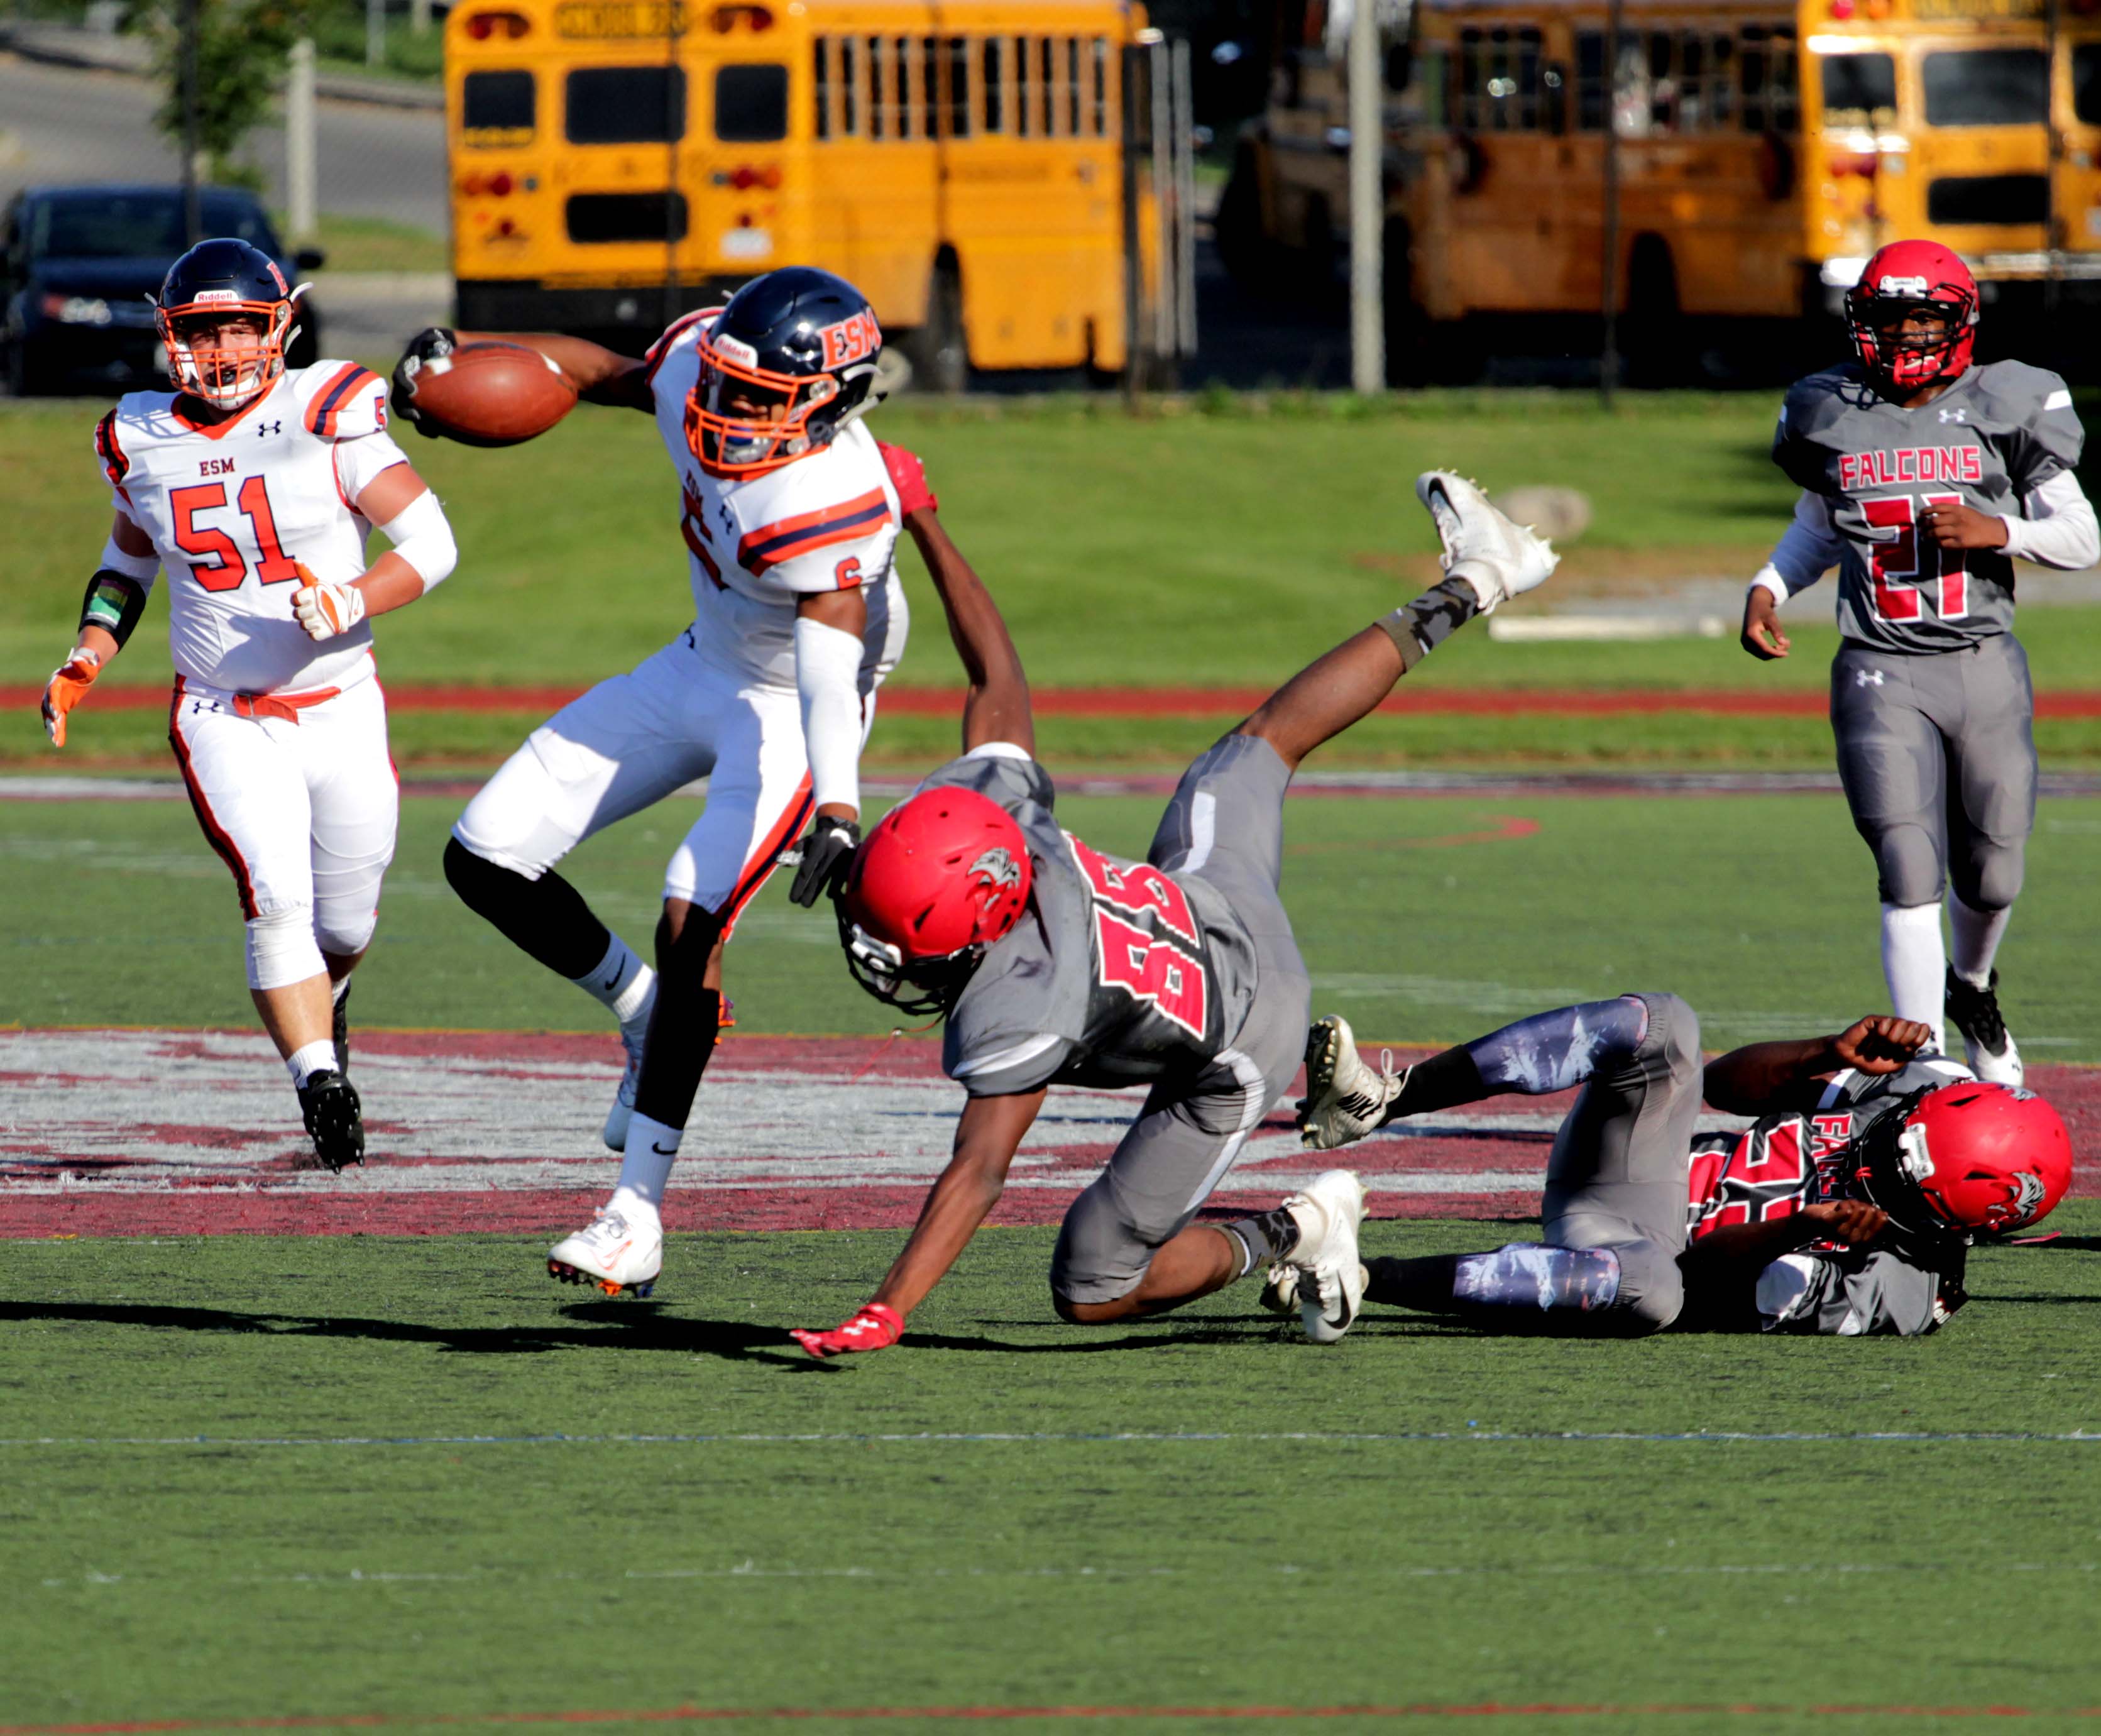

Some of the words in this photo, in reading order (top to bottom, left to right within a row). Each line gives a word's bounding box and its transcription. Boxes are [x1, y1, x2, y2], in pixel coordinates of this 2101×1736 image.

[198, 293, 233, 302] Riddell
[815, 306, 882, 372] ESM
[199, 457, 236, 477] ESM
[1838, 445, 1983, 492] FALCONS
[168, 473, 299, 593] 51
[1857, 492, 1970, 624] 21
